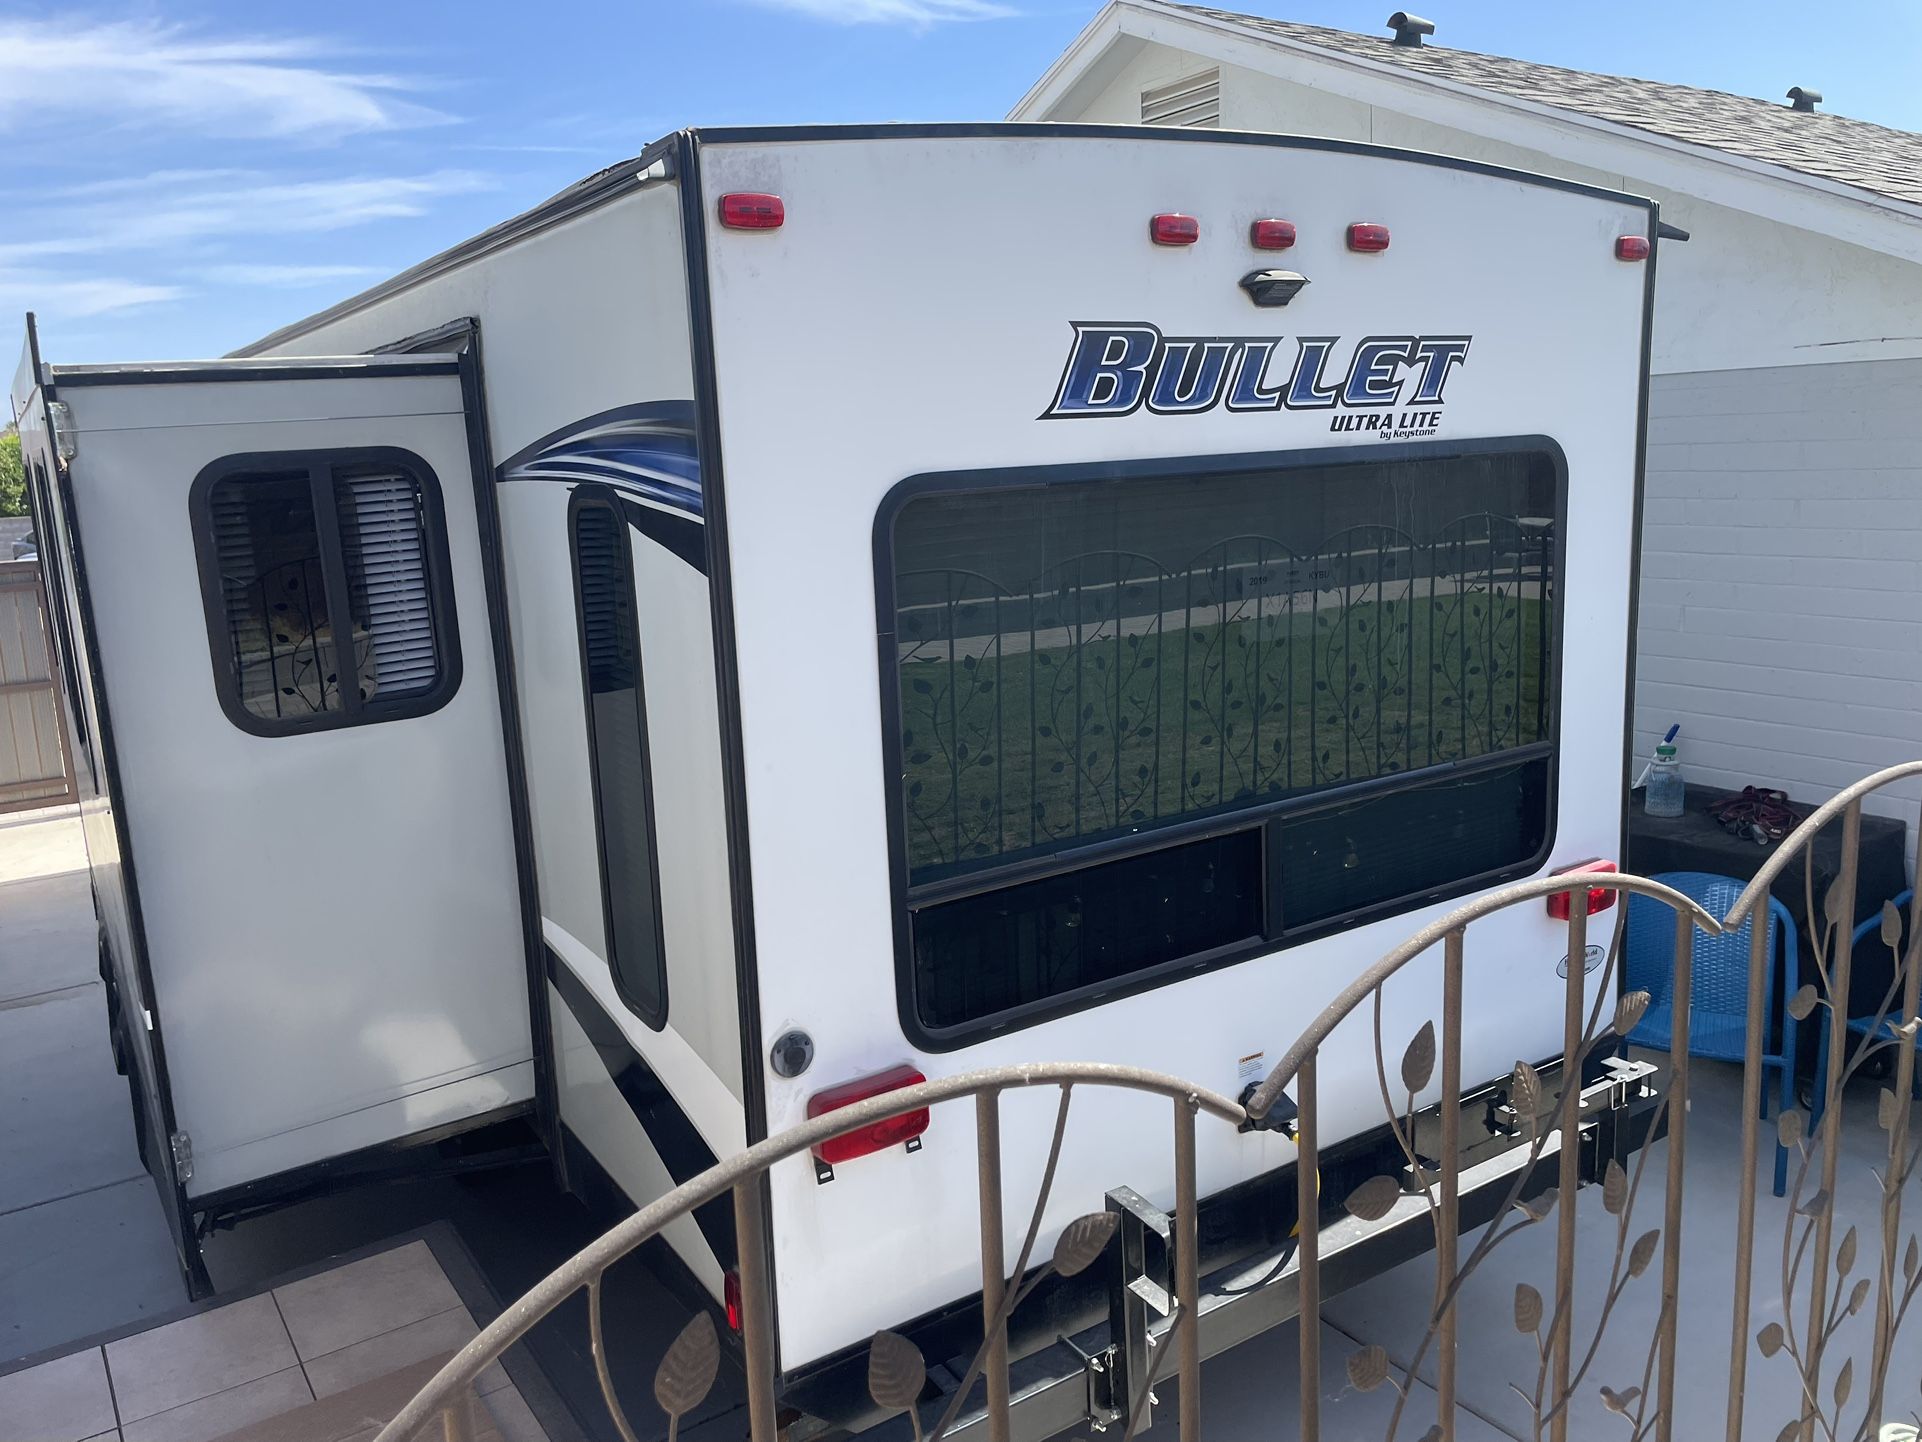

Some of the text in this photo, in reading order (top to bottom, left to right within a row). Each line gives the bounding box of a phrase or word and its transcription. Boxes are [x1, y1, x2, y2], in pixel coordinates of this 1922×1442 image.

[1036, 321, 1472, 420] BULLET
[1330, 411, 1442, 432] ULTRA LITE
[1380, 428, 1436, 440] by Keystone
